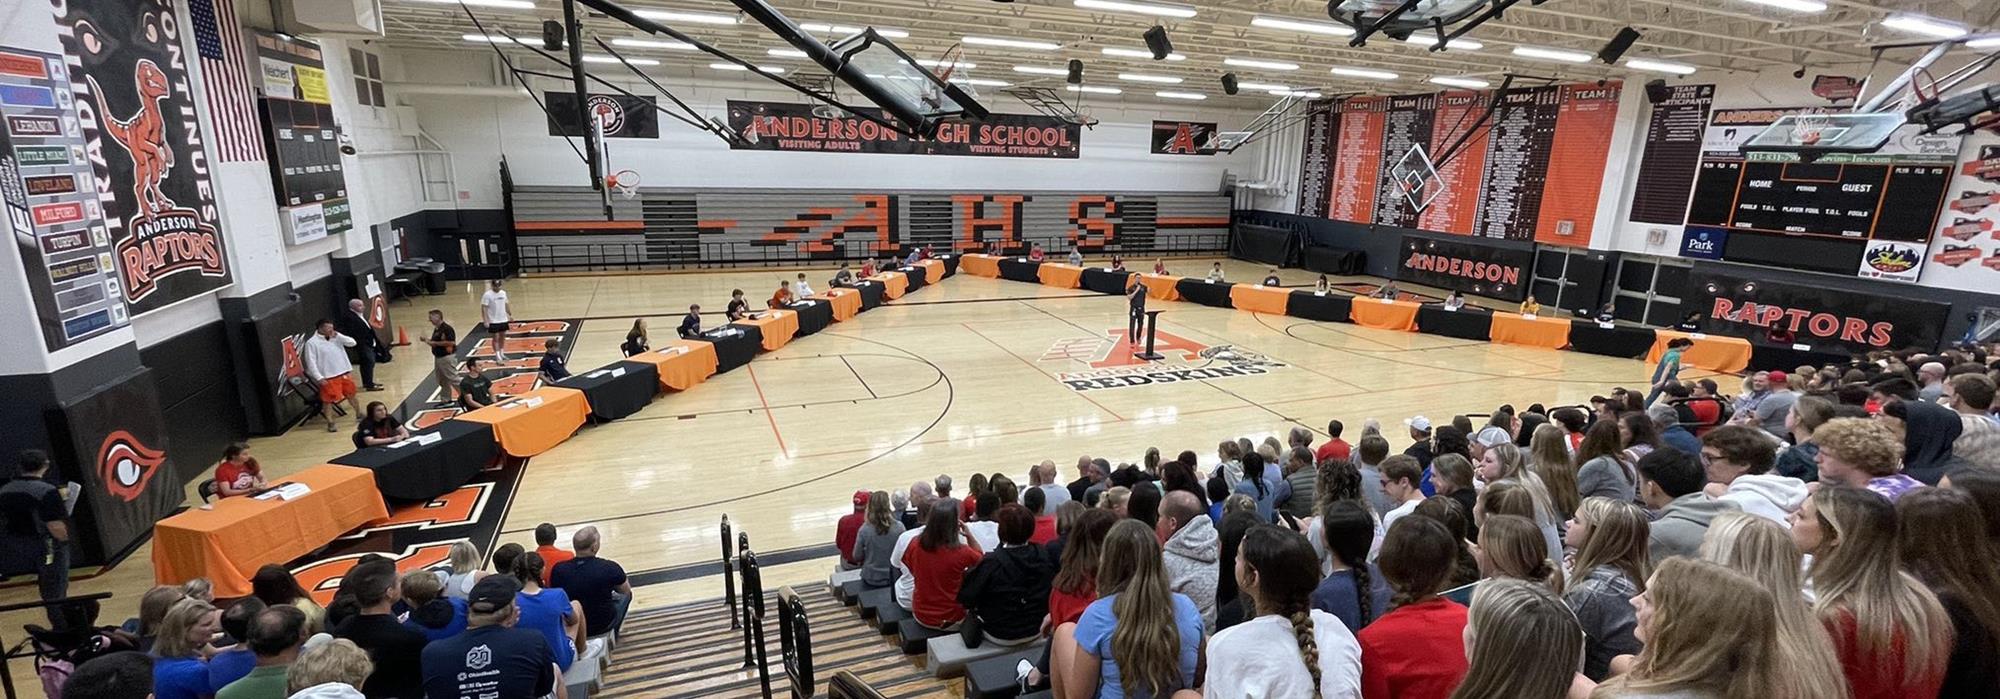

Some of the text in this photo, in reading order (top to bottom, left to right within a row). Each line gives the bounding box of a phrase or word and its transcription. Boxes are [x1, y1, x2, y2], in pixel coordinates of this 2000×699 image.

[1506, 93, 1534, 103] TEAM
[1575, 89, 1606, 99] TEAM
[1394, 99, 1416, 108] TEAM
[1447, 97, 1471, 105] TEAM
[1655, 97, 1712, 106] ARTICIPANTS
[157, 0, 217, 222] ONTINUES
[753, 114, 898, 142] ANDERSON
[979, 124, 1071, 147] SCHOOL
[778, 139, 861, 150] VISITING ADULTS
[970, 144, 1049, 155] VISITING STUDENTS
[1749, 180, 1773, 189] HOME
[1841, 183, 1873, 193] GUEST
[137, 217, 197, 240] ANDERSON
[1689, 238, 1714, 251] Park
[123, 231, 220, 292] RAPTORS
[1408, 252, 1520, 285] ANDERSON
[1711, 297, 1894, 347] RAPTORS
[1062, 364, 1267, 392] REDSKINS
